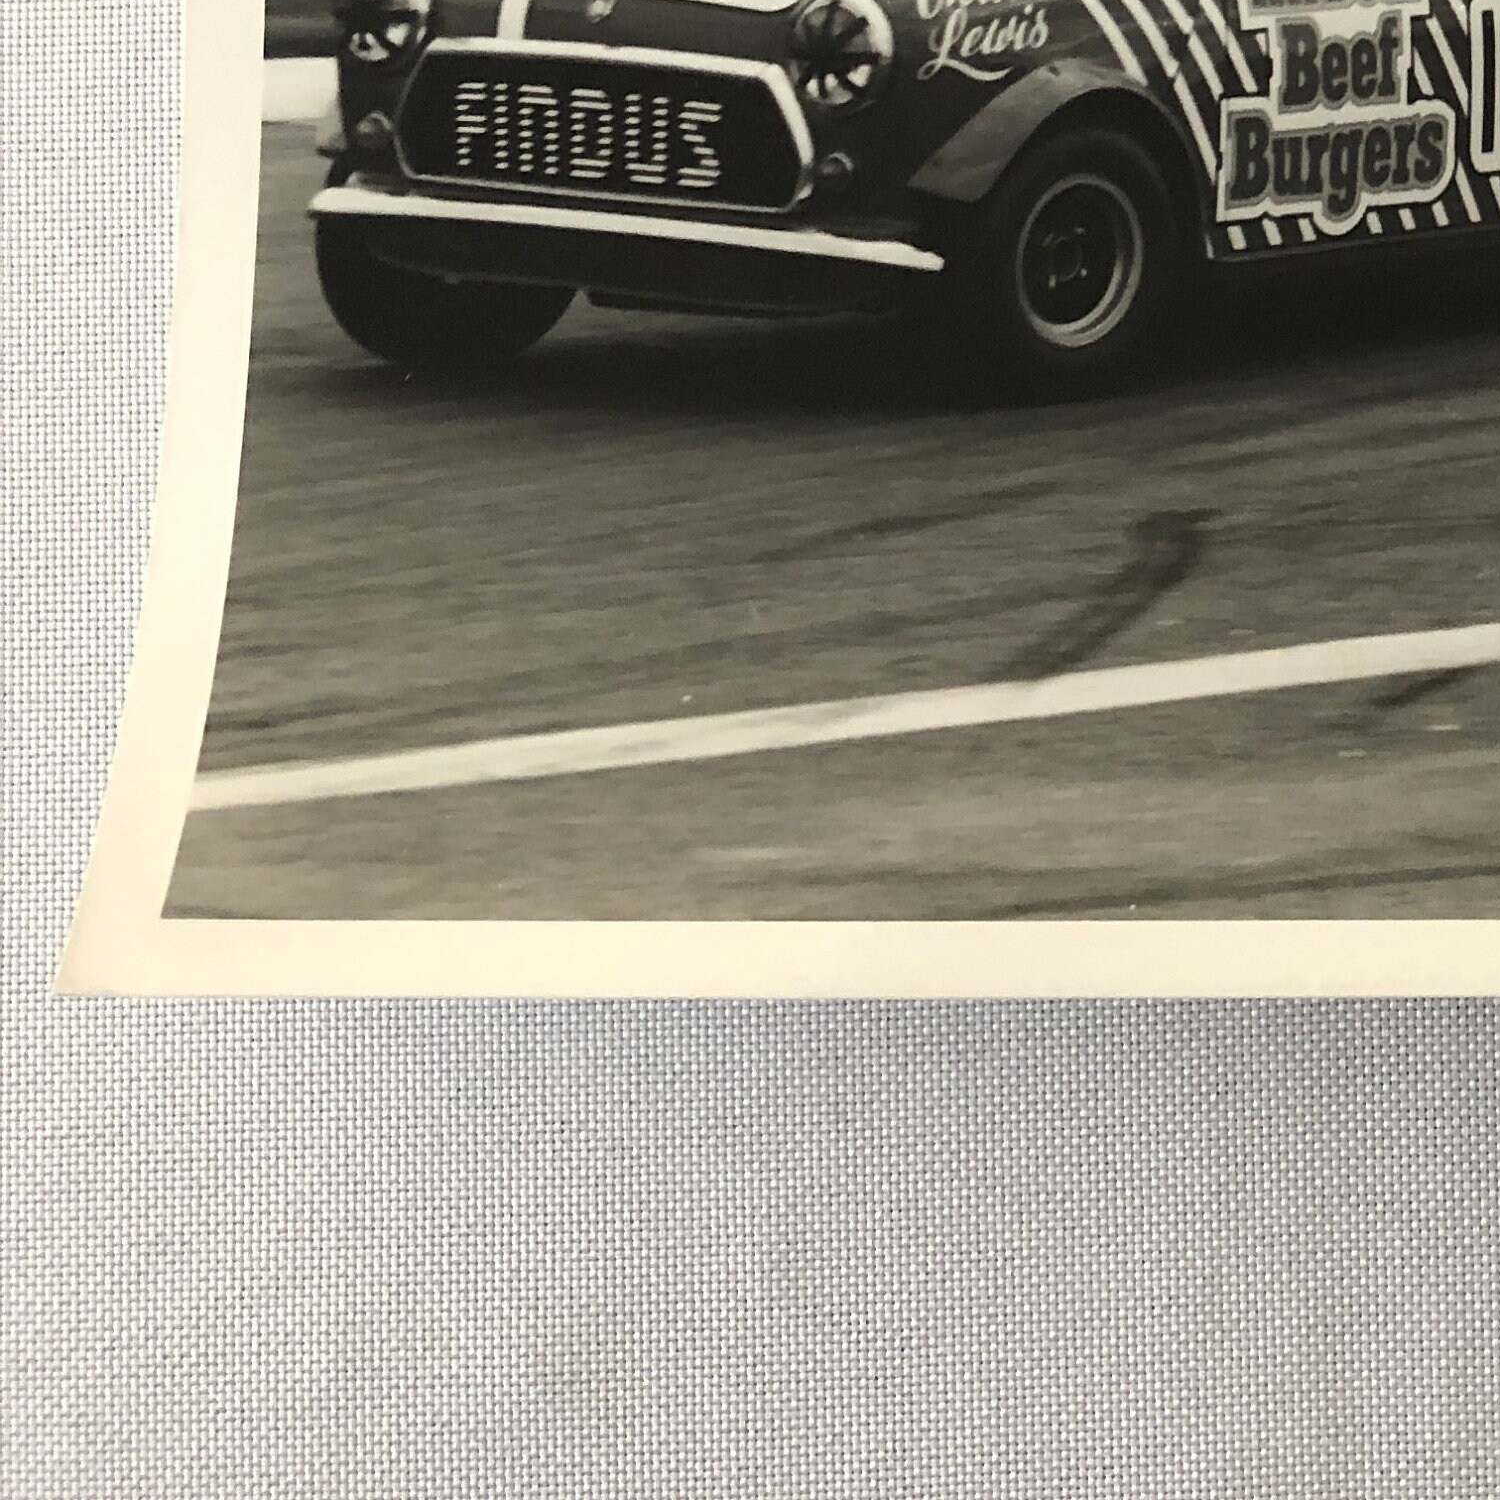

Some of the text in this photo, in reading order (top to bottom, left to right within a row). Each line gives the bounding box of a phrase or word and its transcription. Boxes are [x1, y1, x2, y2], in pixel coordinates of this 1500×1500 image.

[916, 3, 1050, 82] Lewis
[1279, 15, 1402, 106] Beef
[454, 81, 723, 188] FINDUS
[1229, 114, 1444, 213] Burgers
